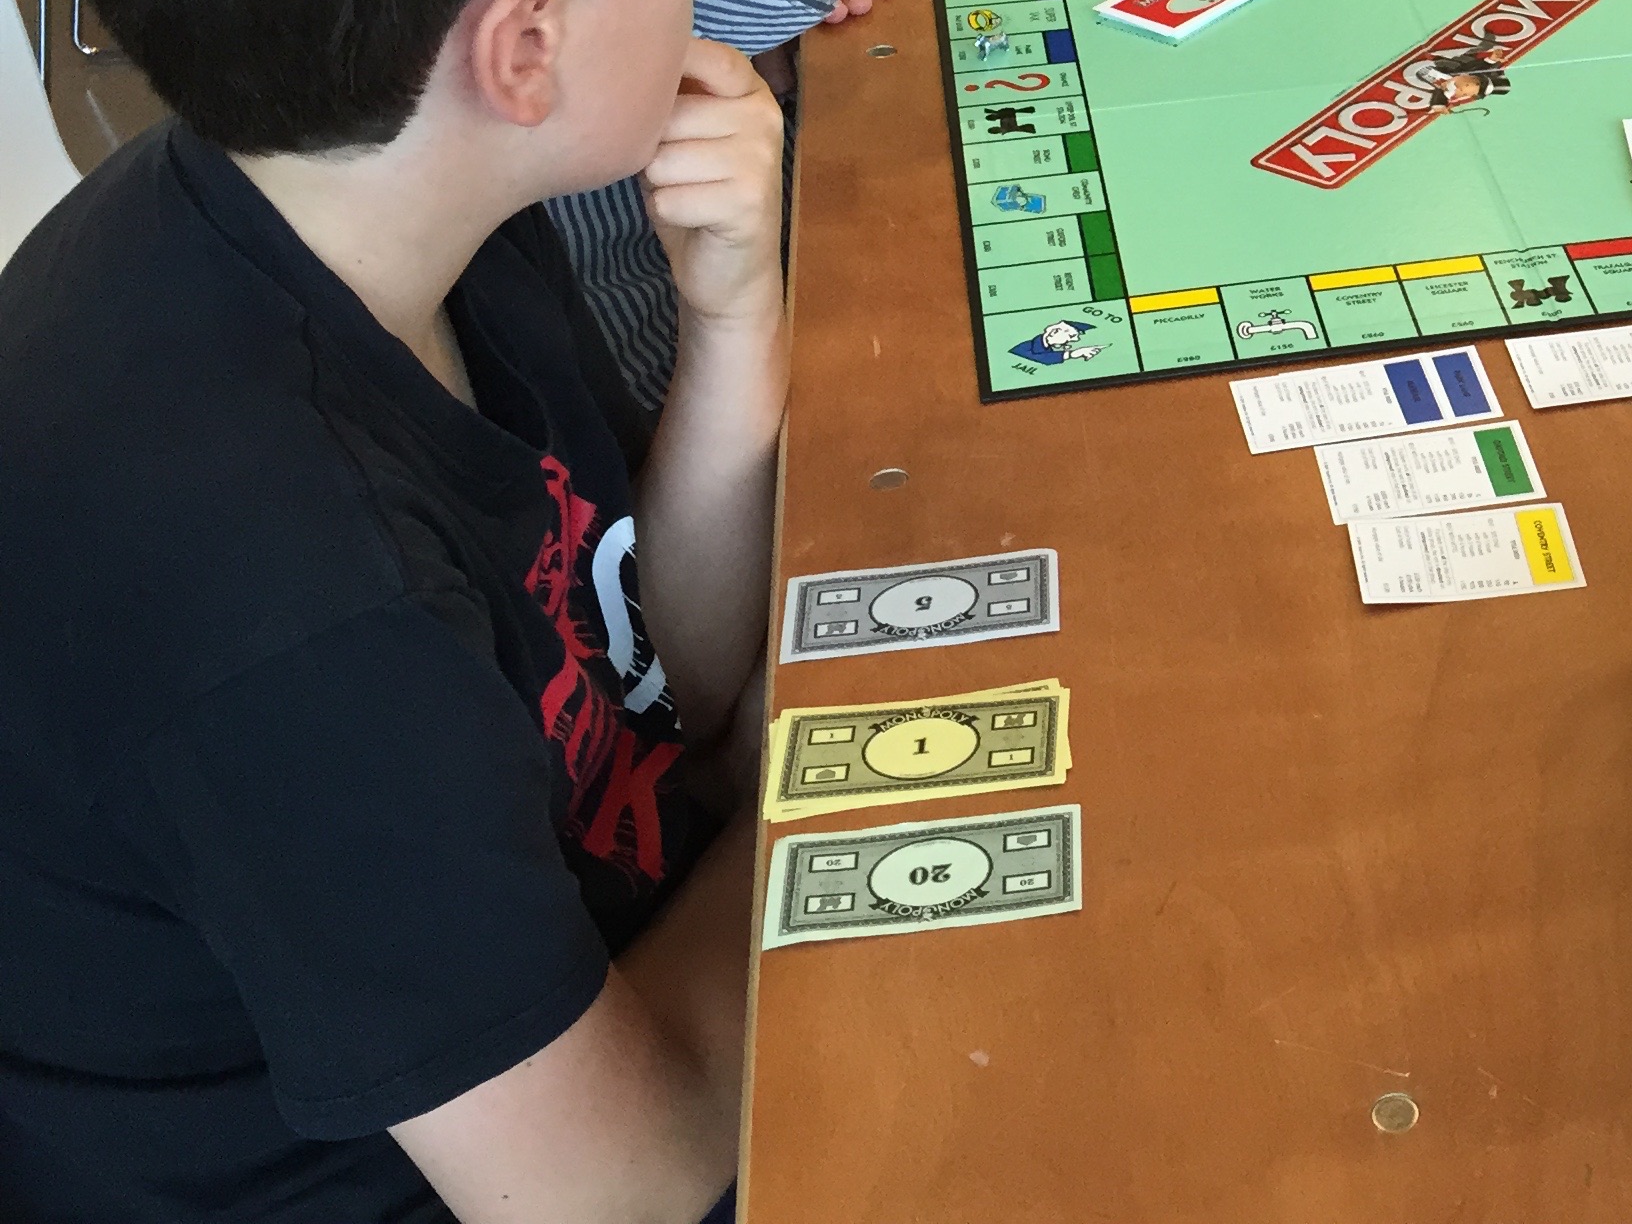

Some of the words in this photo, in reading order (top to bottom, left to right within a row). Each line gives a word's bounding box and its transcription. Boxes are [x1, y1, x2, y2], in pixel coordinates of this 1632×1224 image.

[1082, 305, 1103, 317] GO
[1104, 312, 1123, 324] TO
[1153, 312, 1206, 325] PICCADILLY
[1011, 362, 1038, 376] JAIL
[915, 595, 933, 612] 5
[912, 737, 930, 756] 1
[908, 863, 952, 885] 20
